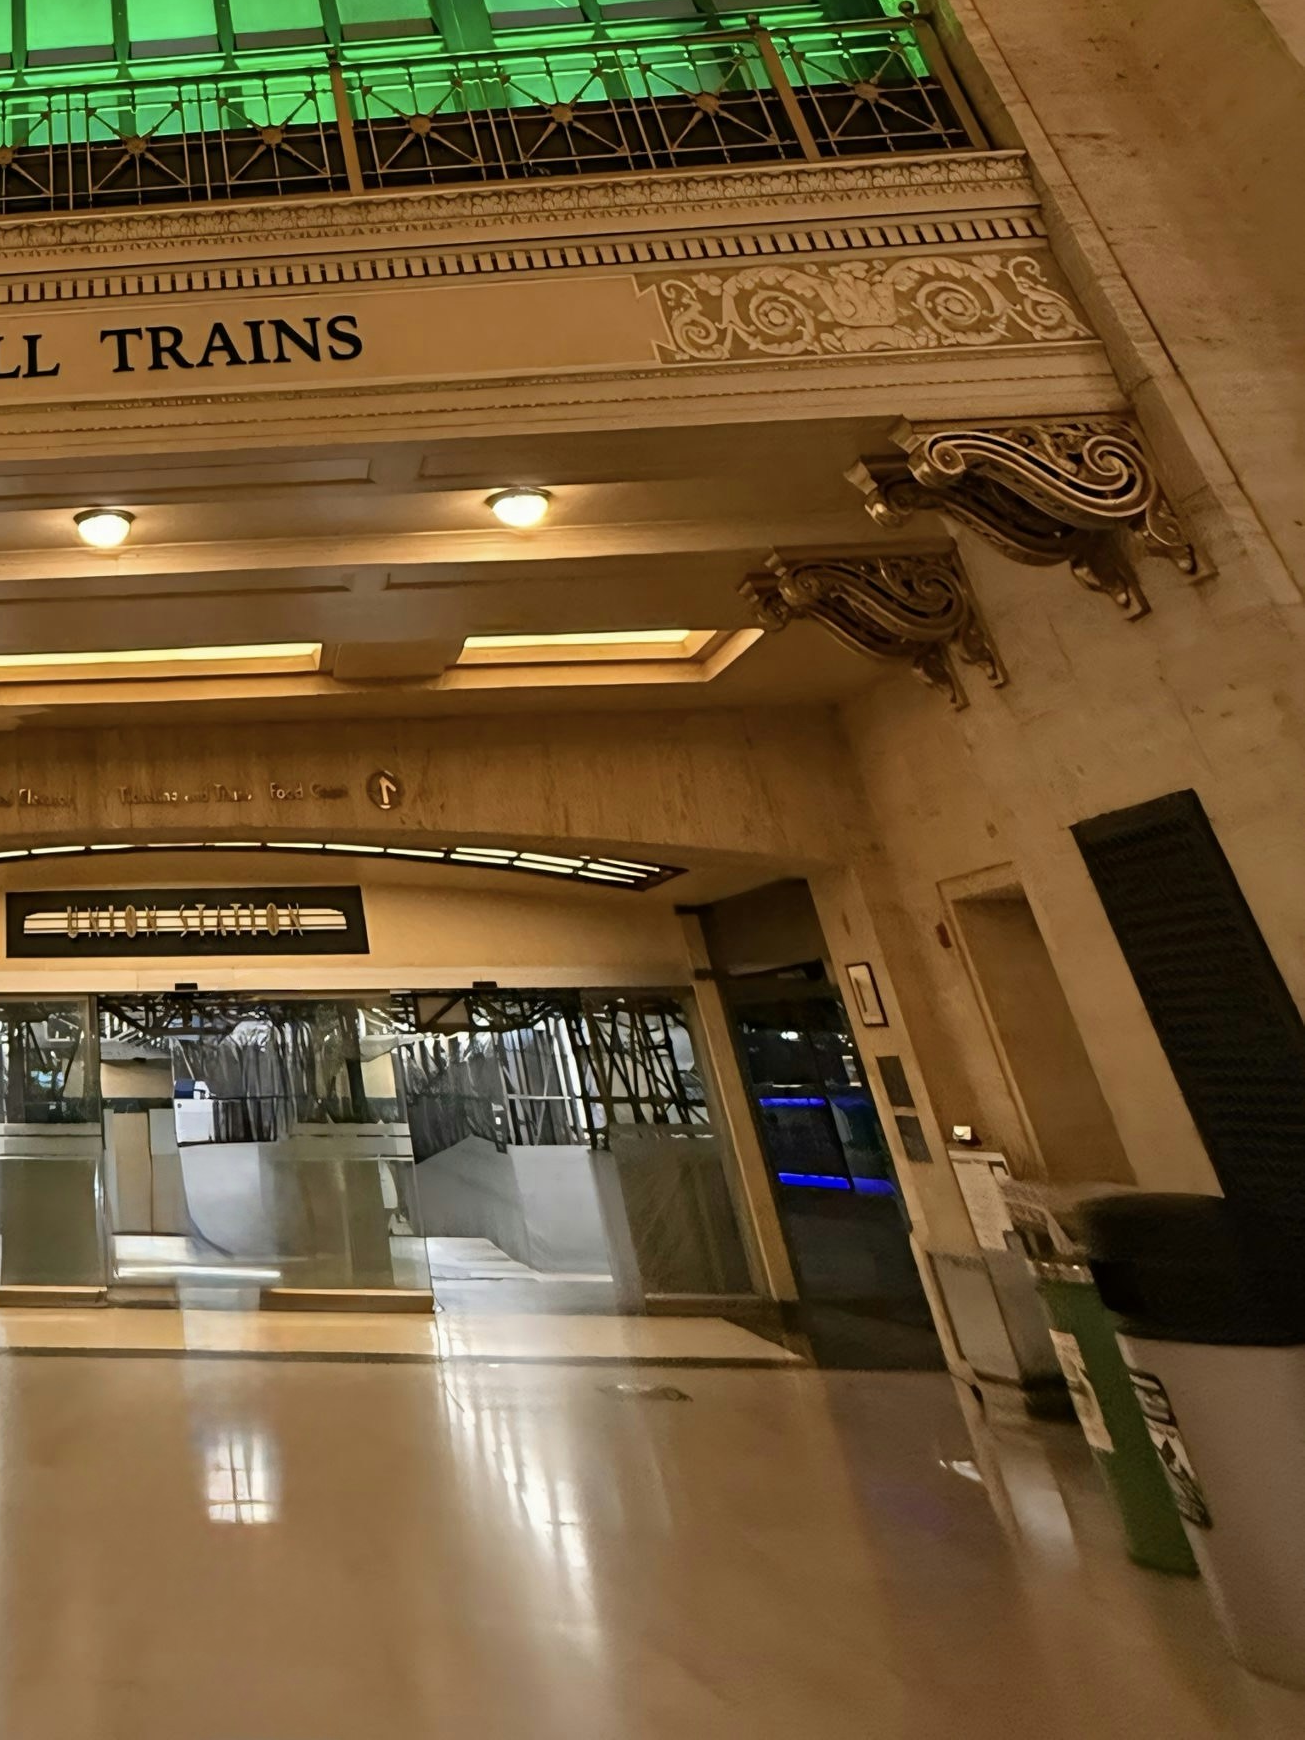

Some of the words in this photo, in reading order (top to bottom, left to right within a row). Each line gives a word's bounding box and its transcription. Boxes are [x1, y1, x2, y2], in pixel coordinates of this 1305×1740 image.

[99, 313, 365, 373] TRAINS
[66, 904, 159, 939] UNION
[178, 902, 304, 938] STATION
